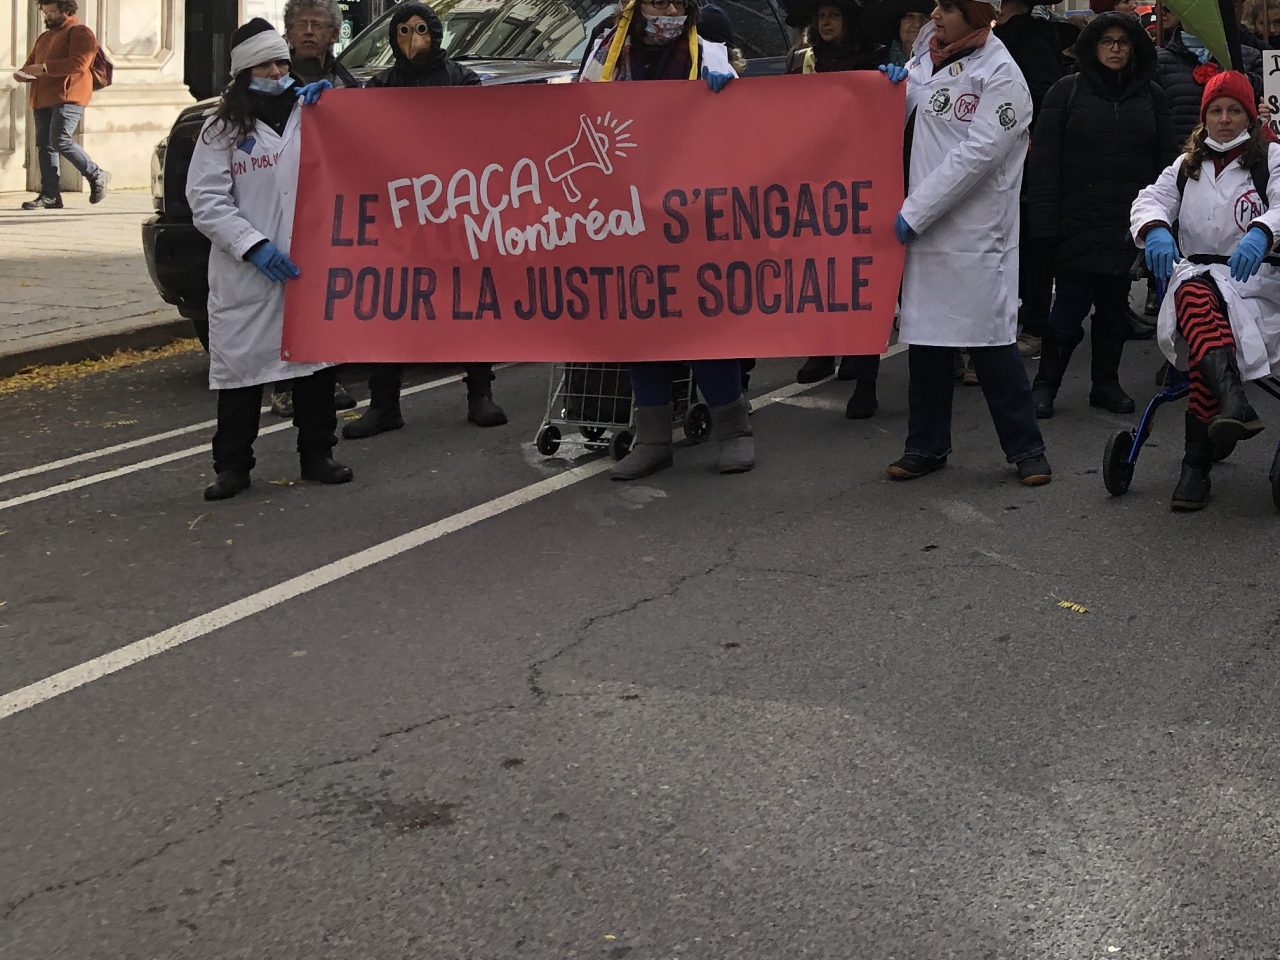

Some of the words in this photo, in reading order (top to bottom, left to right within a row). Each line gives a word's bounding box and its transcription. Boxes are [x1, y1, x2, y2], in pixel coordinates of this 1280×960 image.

[331, 193, 379, 247] LE
[387, 157, 542, 228] FRACA
[464, 185, 646, 260] Montréal
[663, 180, 874, 244] S'ENGAGE
[323, 266, 437, 321] POUR
[451, 266, 502, 321] LA
[514, 264, 684, 320] JUSTICE
[697, 256, 874, 320] SOCIALE
